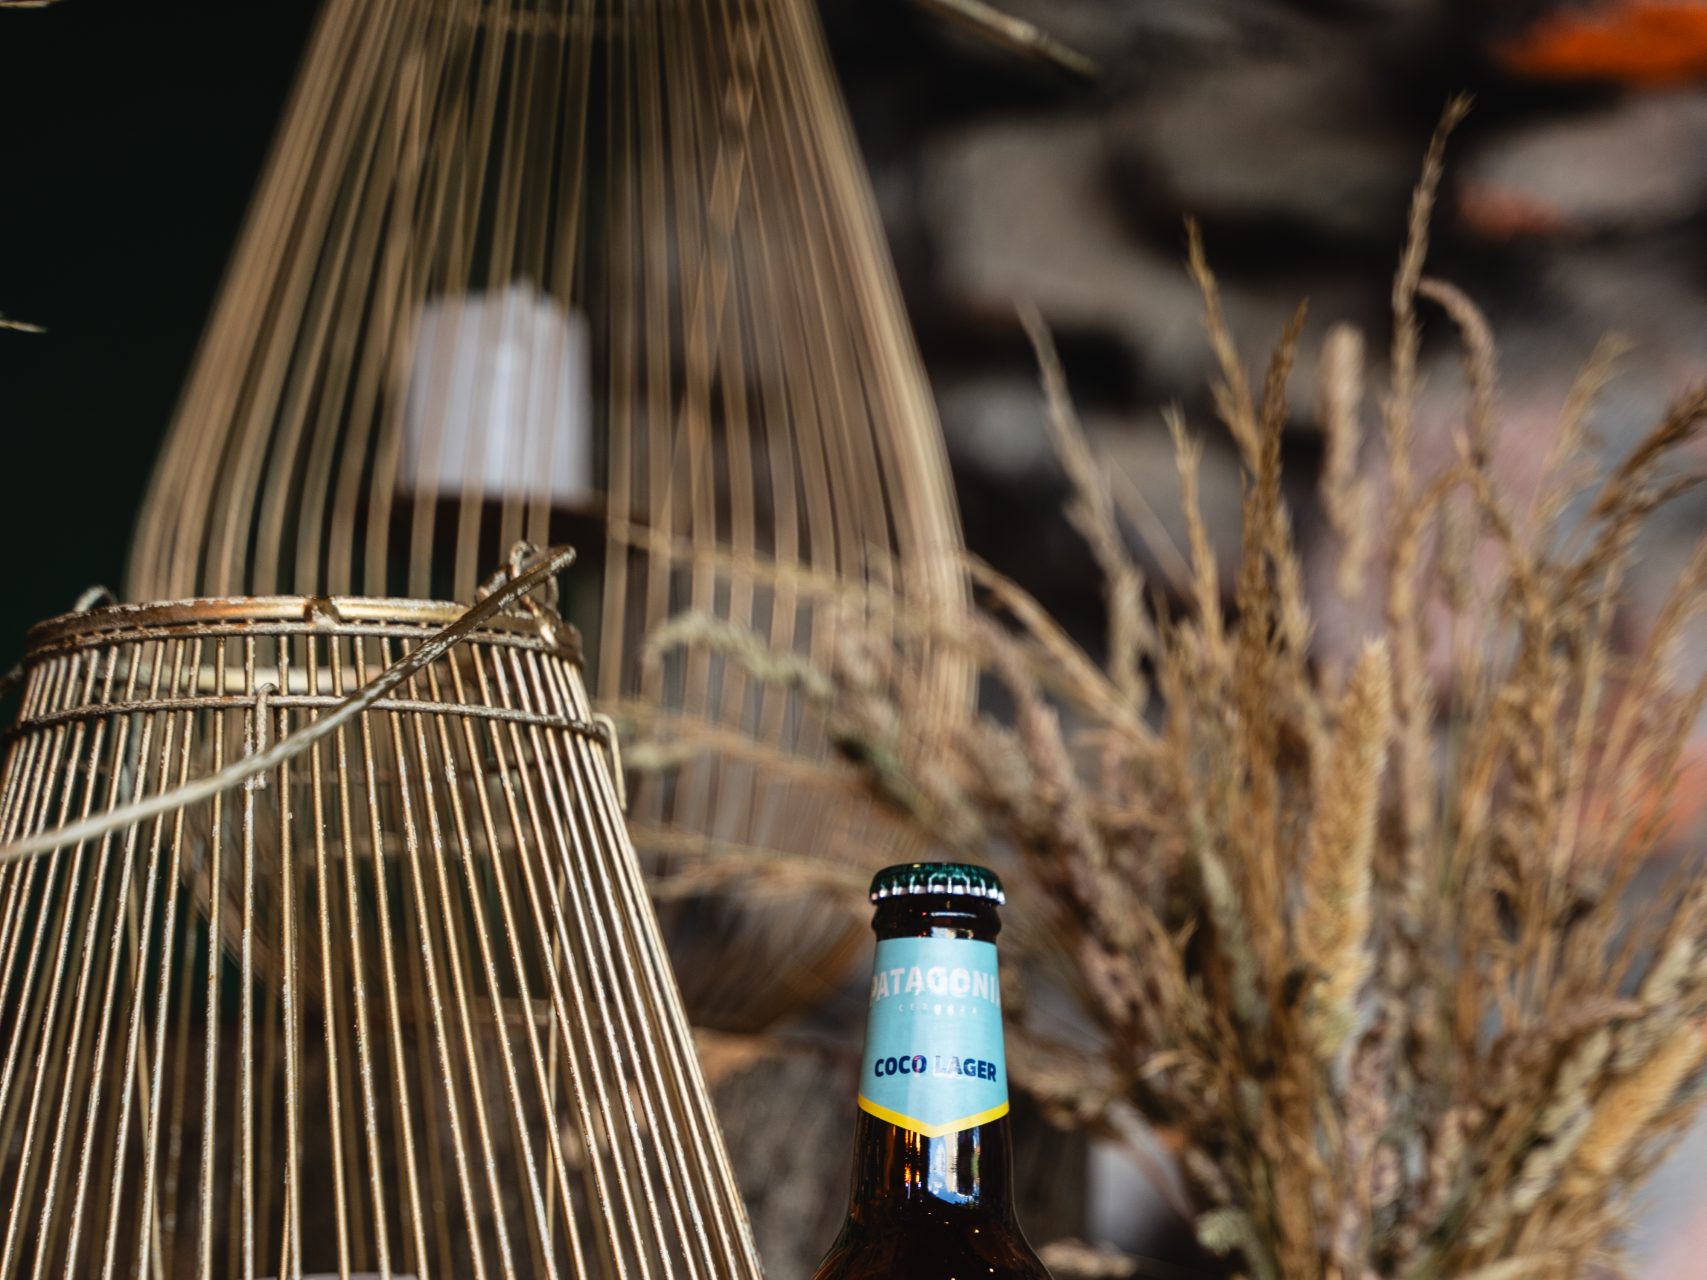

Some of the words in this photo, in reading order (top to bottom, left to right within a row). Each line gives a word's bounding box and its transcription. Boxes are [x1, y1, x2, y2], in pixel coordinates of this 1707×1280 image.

[870, 966, 1001, 1008] PATAGONI
[875, 1055, 927, 1077] COCO
[934, 1056, 997, 1082] LAGER
